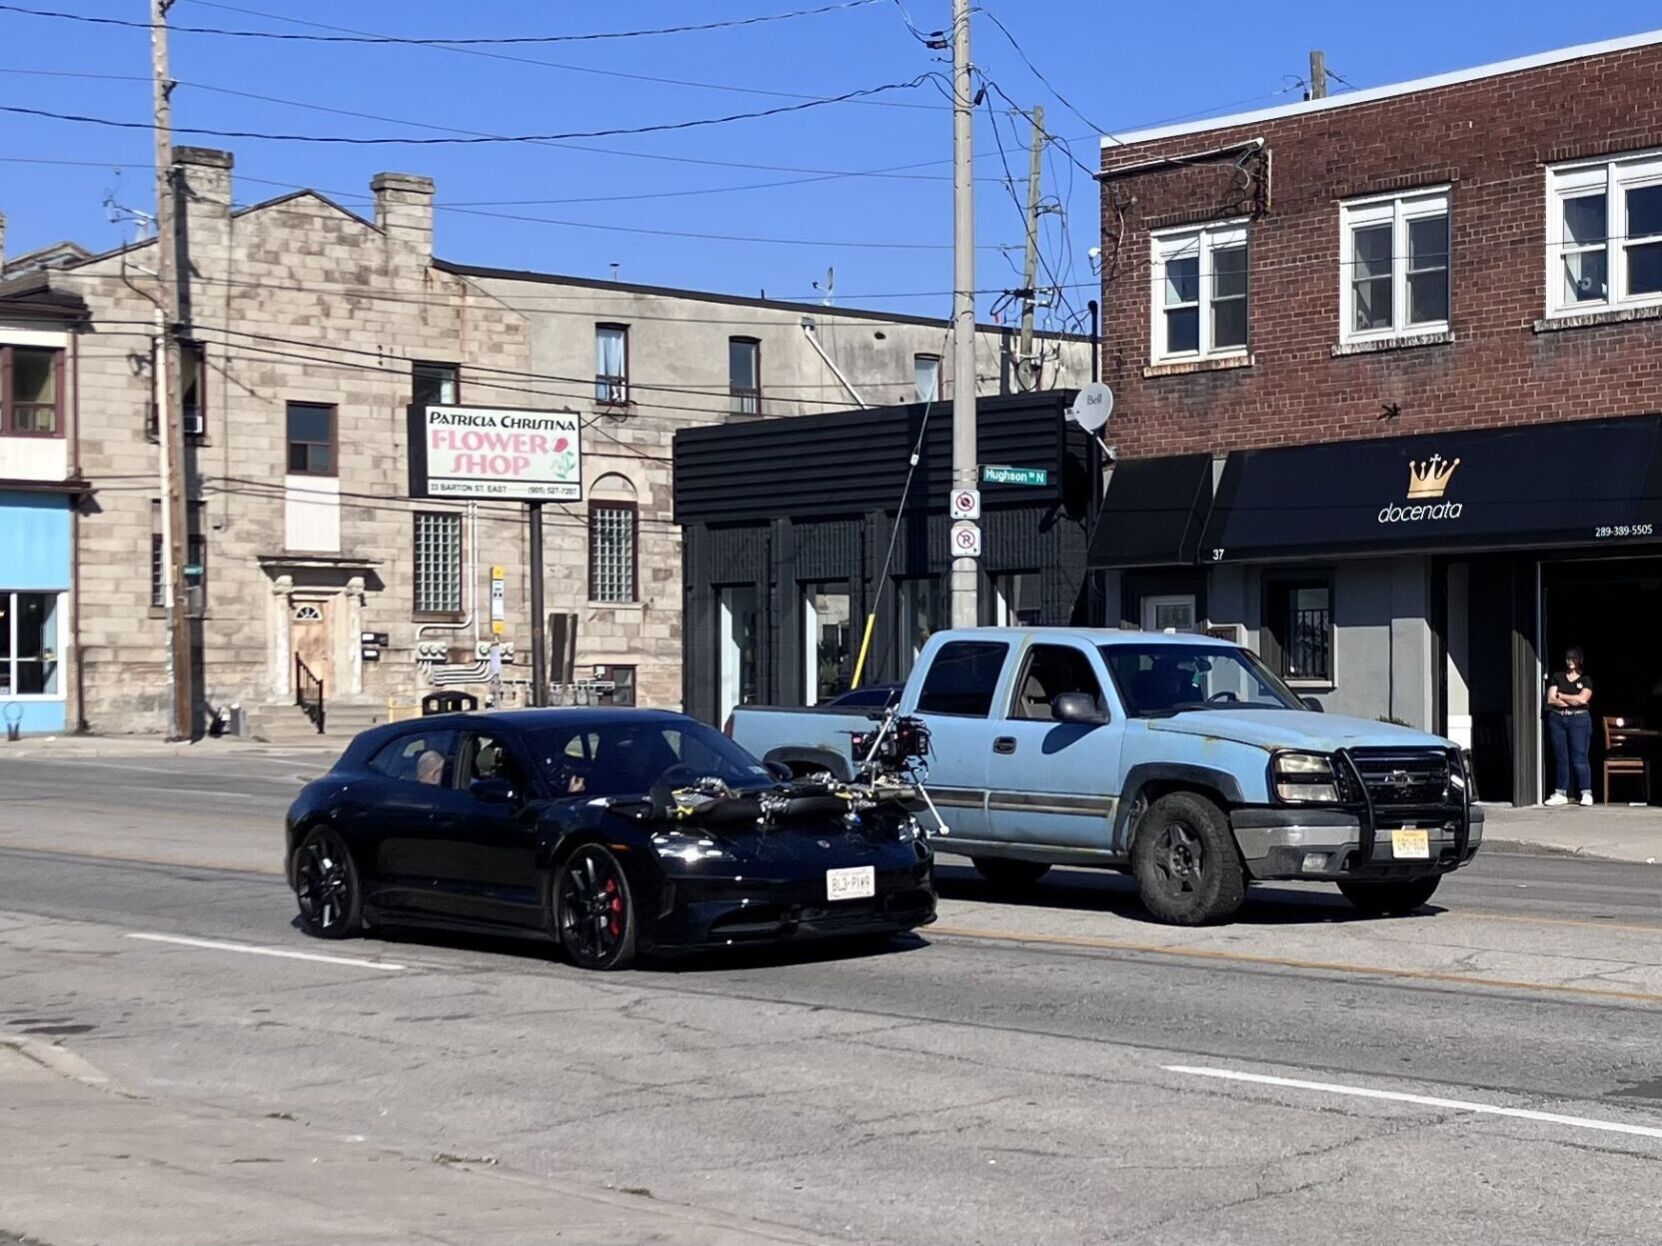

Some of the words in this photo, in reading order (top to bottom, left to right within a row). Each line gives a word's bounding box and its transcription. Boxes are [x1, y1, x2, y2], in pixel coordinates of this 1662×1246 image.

[1087, 394, 1102, 405] Bell
[429, 411, 496, 428] PATRICIA
[500, 415, 576, 431] CHRISTINA
[432, 429, 549, 454] FLOWER
[451, 453, 531, 476] SHOP
[985, 469, 1028, 483] Hughson
[1036, 473, 1044, 483] N
[441, 483, 473, 492] BARTON
[487, 485, 507, 493] EAST
[1378, 501, 1463, 523] docenata
[1595, 524, 1654, 537] 289-389-5505
[1212, 548, 1225, 560] 37
